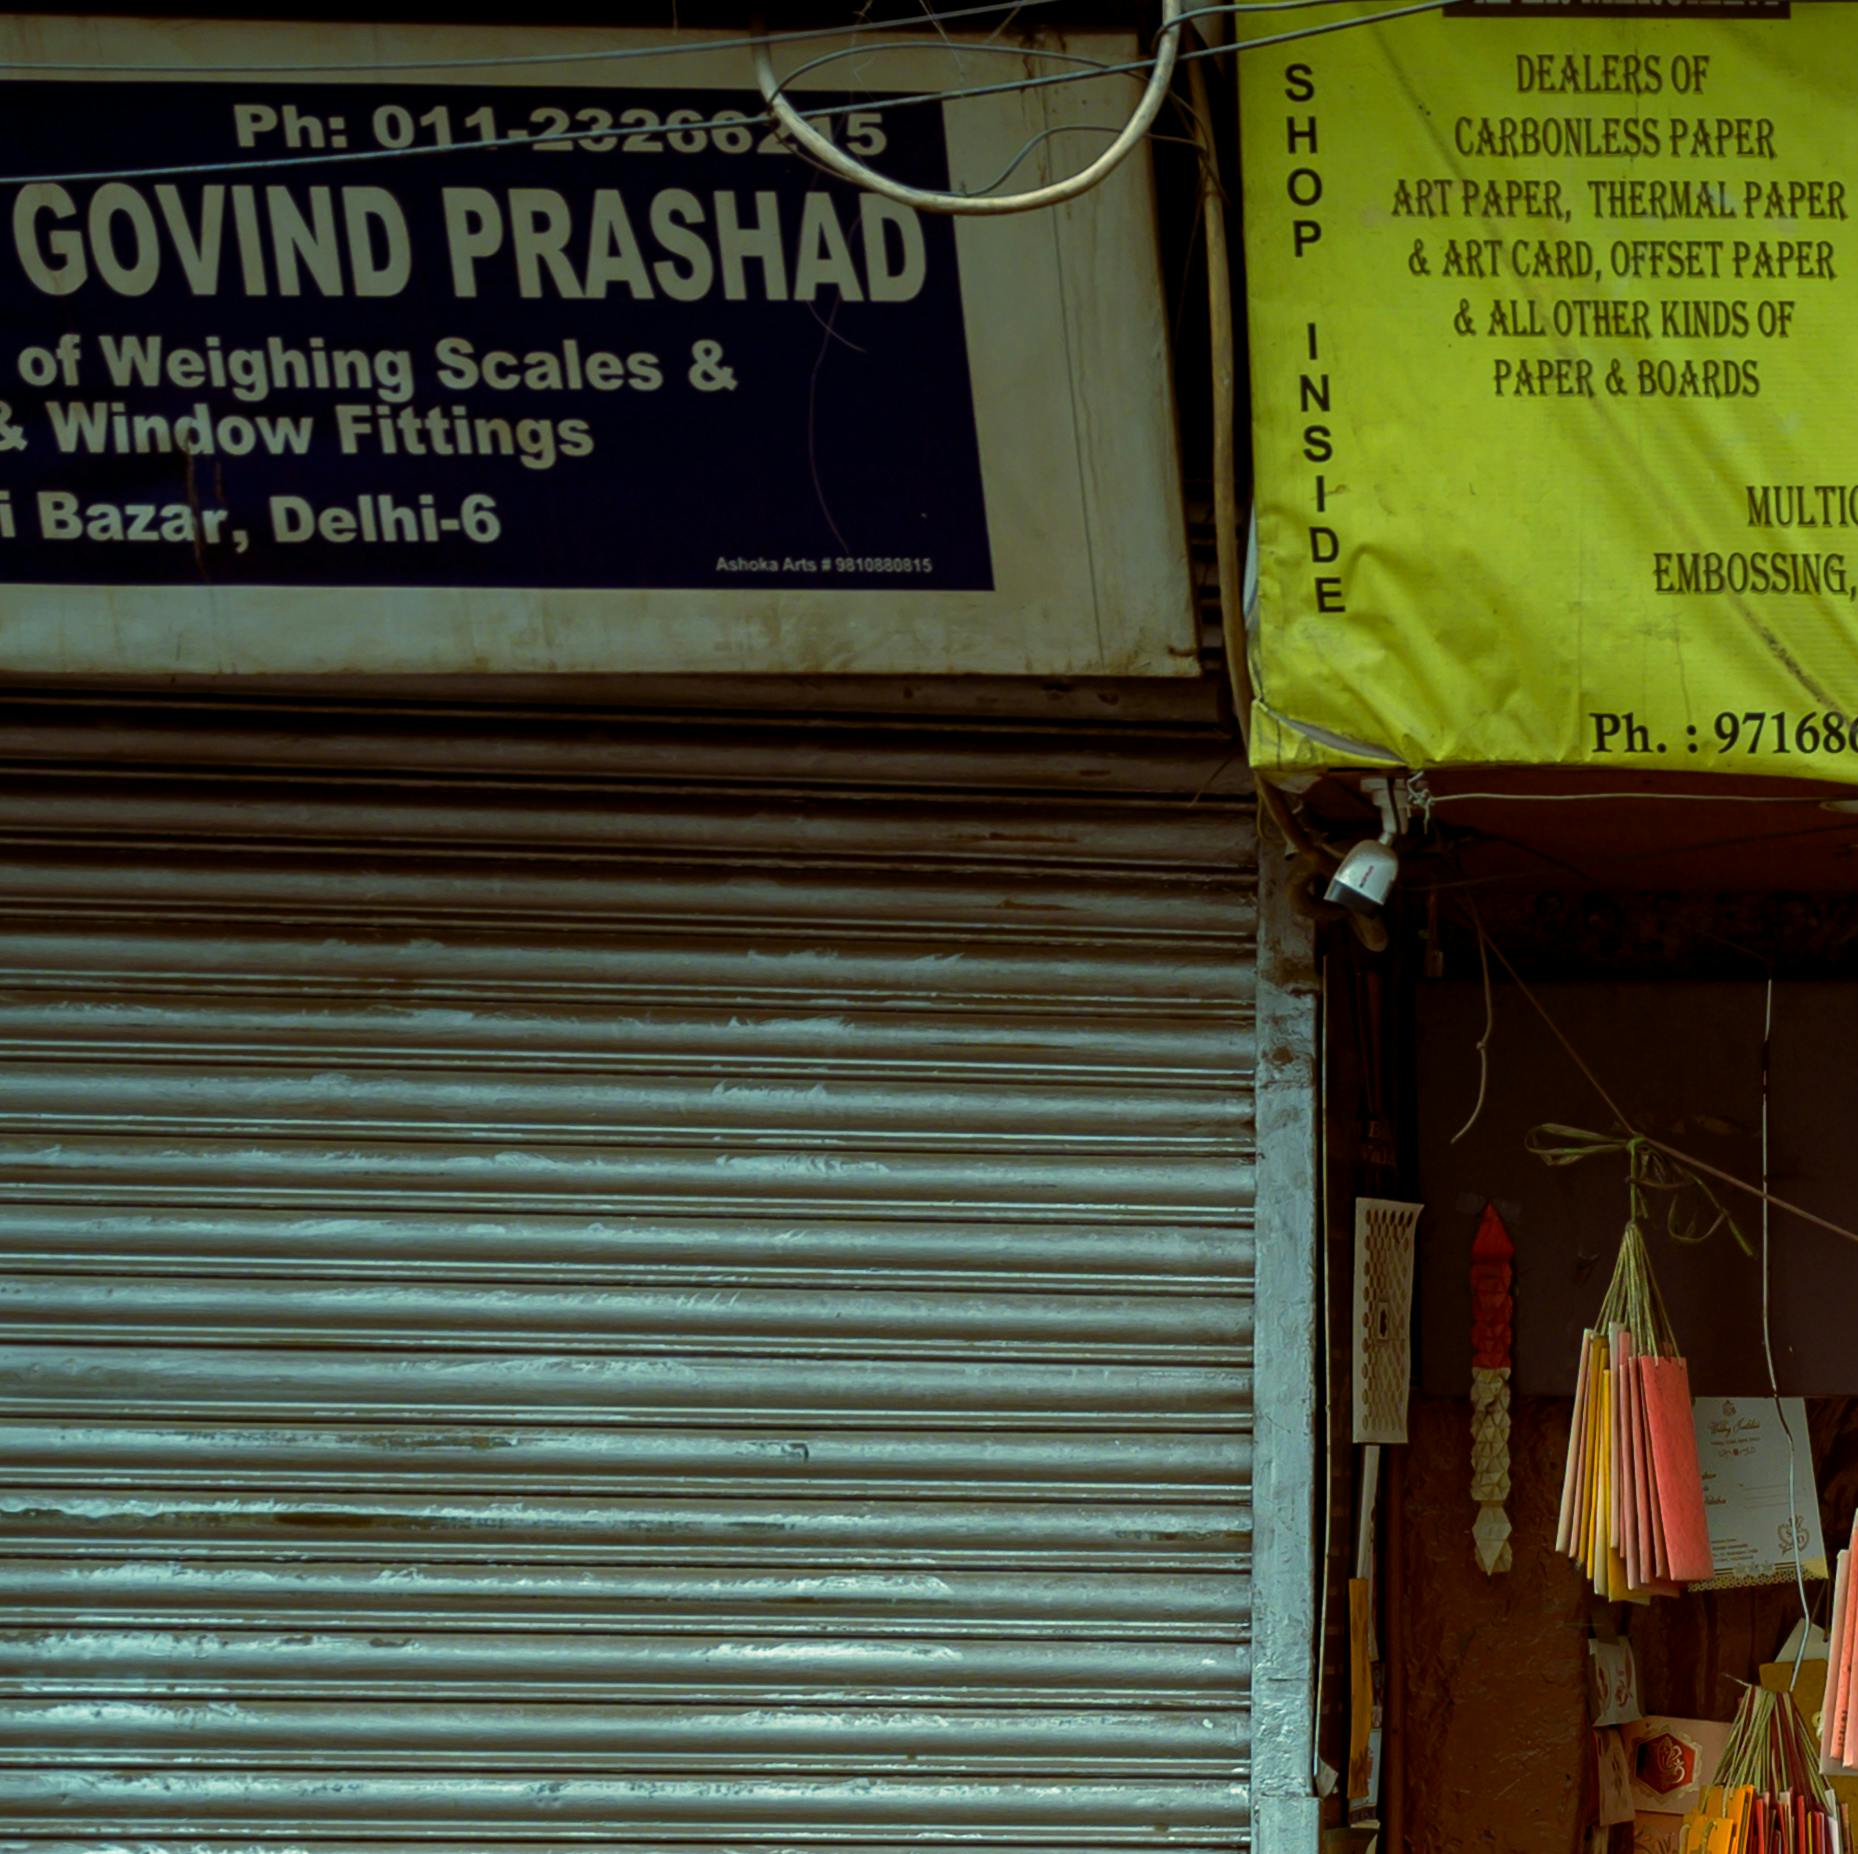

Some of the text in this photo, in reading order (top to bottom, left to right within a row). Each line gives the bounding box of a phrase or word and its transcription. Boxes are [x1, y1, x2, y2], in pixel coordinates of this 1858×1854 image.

[1516, 54, 1711, 96] DEALERS OF
[234, 104, 348, 149] Ph:
[1454, 117, 1778, 160] CARBONLESS PAPER
[1283, 63, 1323, 258] SHOP
[1391, 178, 1849, 223] ART PAPER, THERMAL PAPER
[12, 182, 927, 303] GOVIND PRASHAD
[1408, 240, 1838, 283] & ART CARD, OFFSET PAPER
[1453, 299, 1796, 339] & ALL OTHER KINDS OF
[17, 333, 739, 403] of Weighing Scales &
[1492, 359, 1761, 399] PAPER & BOARDS
[45, 401, 596, 471] Window Fittings
[1299, 321, 1346, 613] INSIDE
[36, 490, 250, 554] Bazar,
[268, 494, 503, 545] Delhi-6
[715, 556, 779, 573] Ashoka
[782, 556, 818, 573] Arts
[1652, 551, 1858, 603] EMBOSSING,
